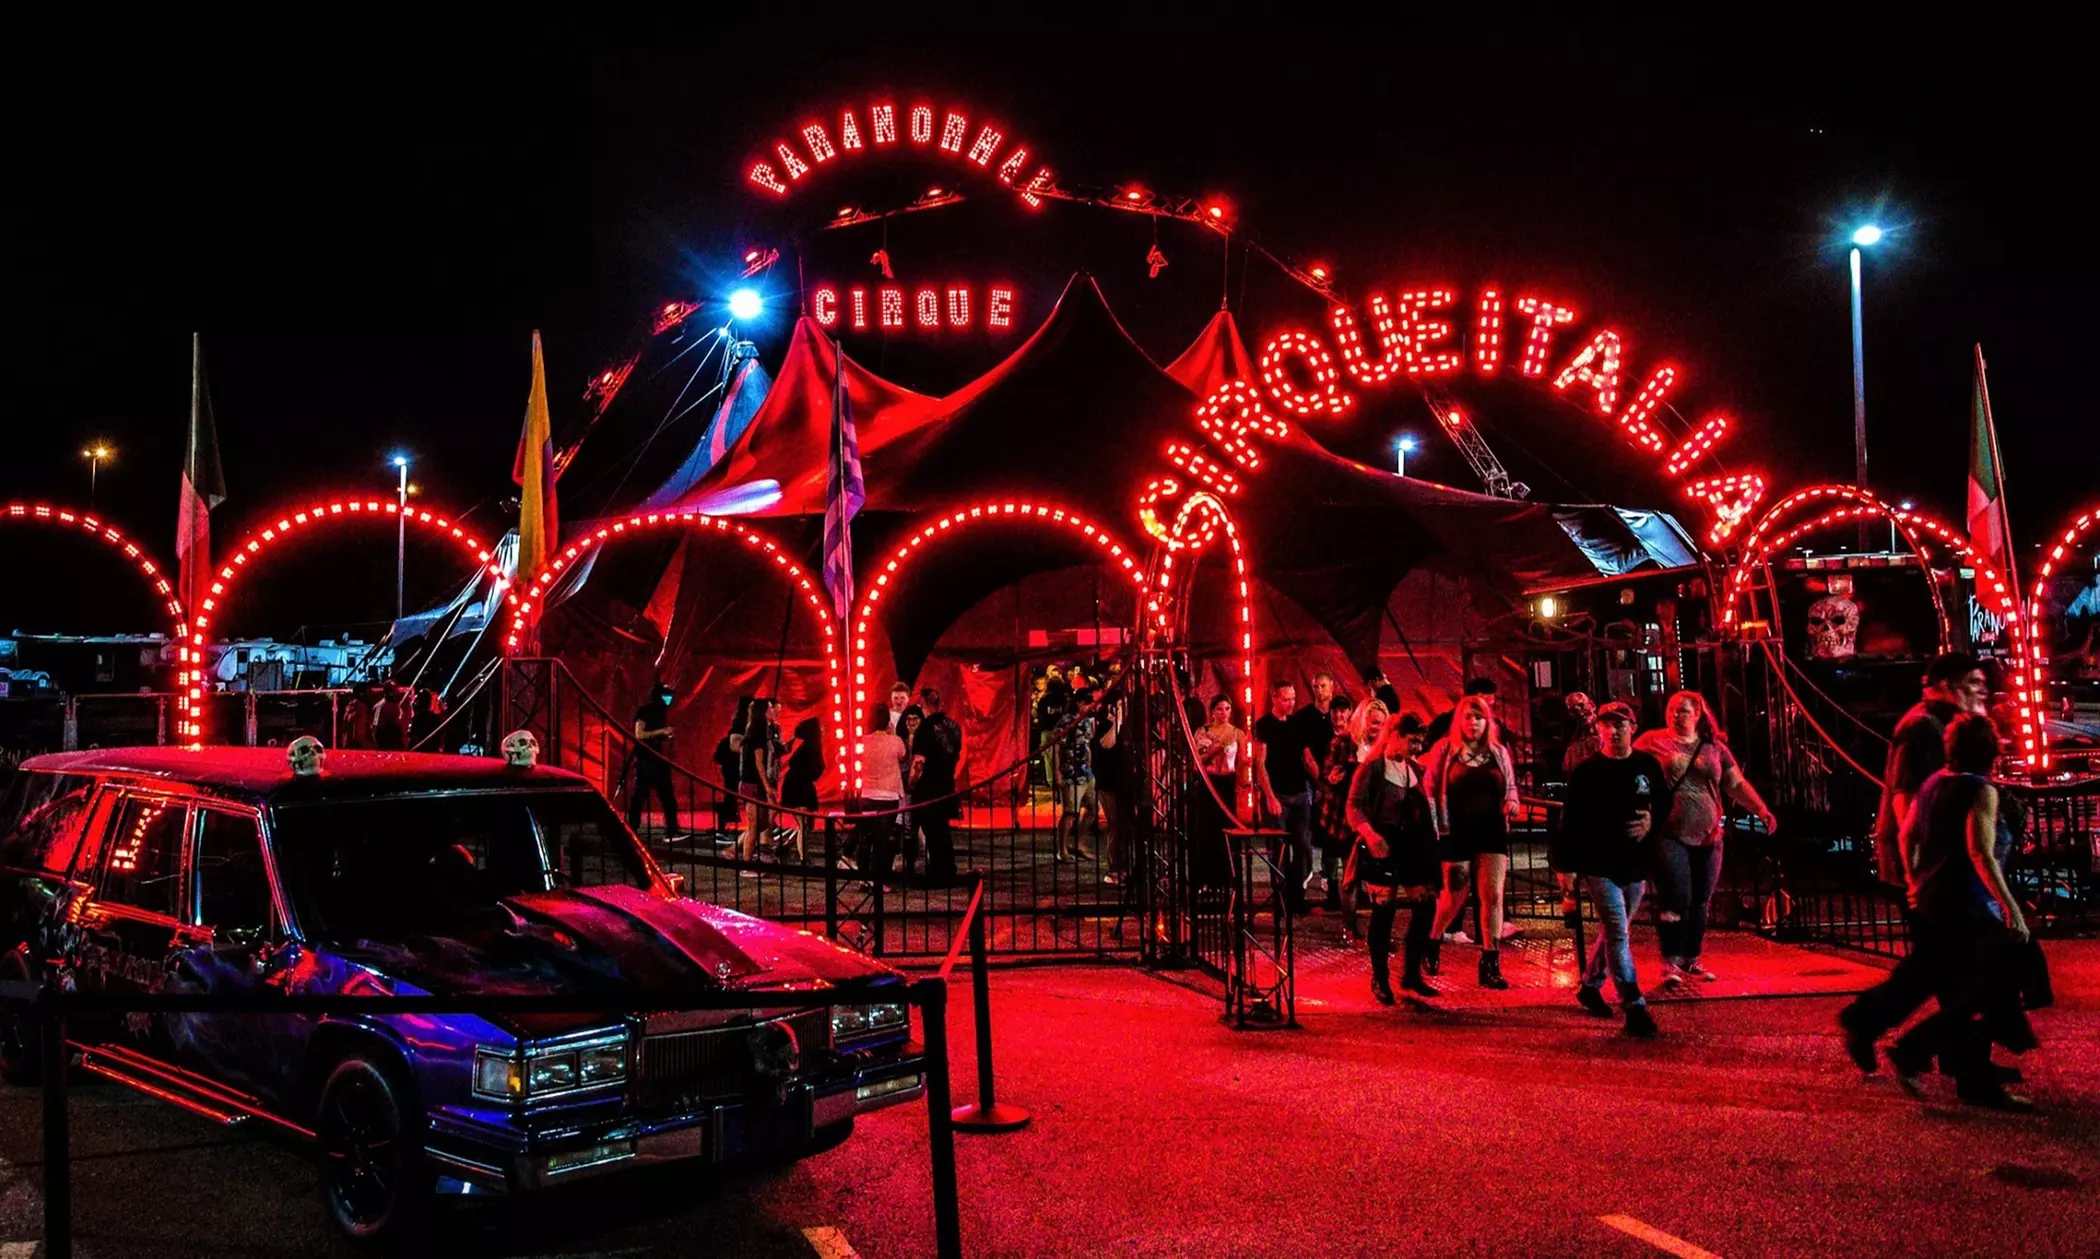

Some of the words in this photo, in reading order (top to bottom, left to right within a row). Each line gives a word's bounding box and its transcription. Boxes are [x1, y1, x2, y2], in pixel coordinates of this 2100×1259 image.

[749, 104, 1050, 208] PARANORMAL
[815, 288, 1012, 327] CIRQUE
[1480, 288, 1765, 545] ITALIA
